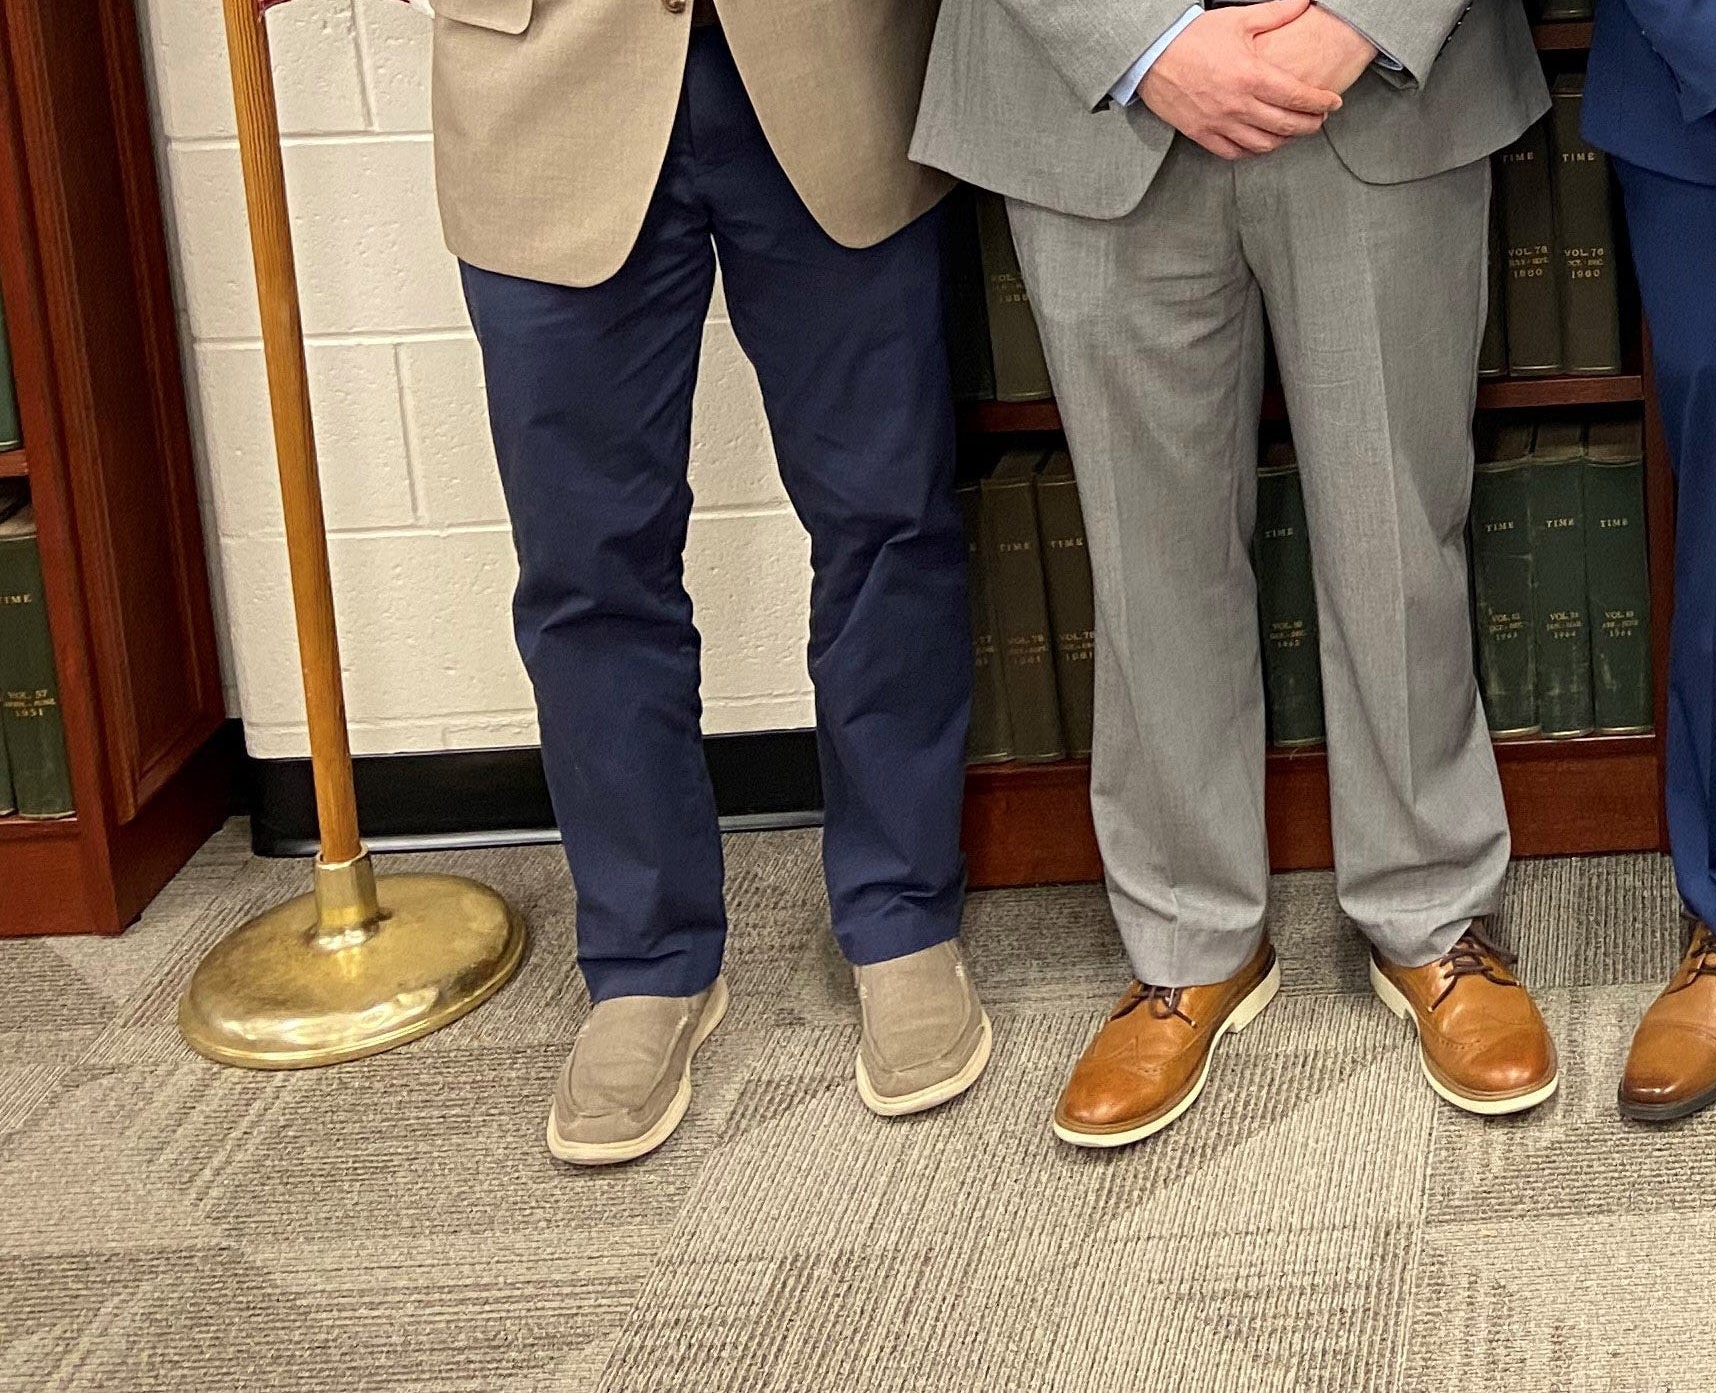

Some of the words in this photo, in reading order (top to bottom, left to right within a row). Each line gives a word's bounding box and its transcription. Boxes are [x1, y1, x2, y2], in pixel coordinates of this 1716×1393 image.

[1503, 152, 1534, 162] TIME
[1562, 152, 1595, 162] TIME
[1487, 521, 1514, 532] TIME
[1546, 518, 1574, 529] TIME
[1600, 518, 1629, 528] TIME
[1264, 528, 1294, 539] TIME
[1000, 542, 1030, 552] TIME
[1050, 538, 1084, 548] TIME
